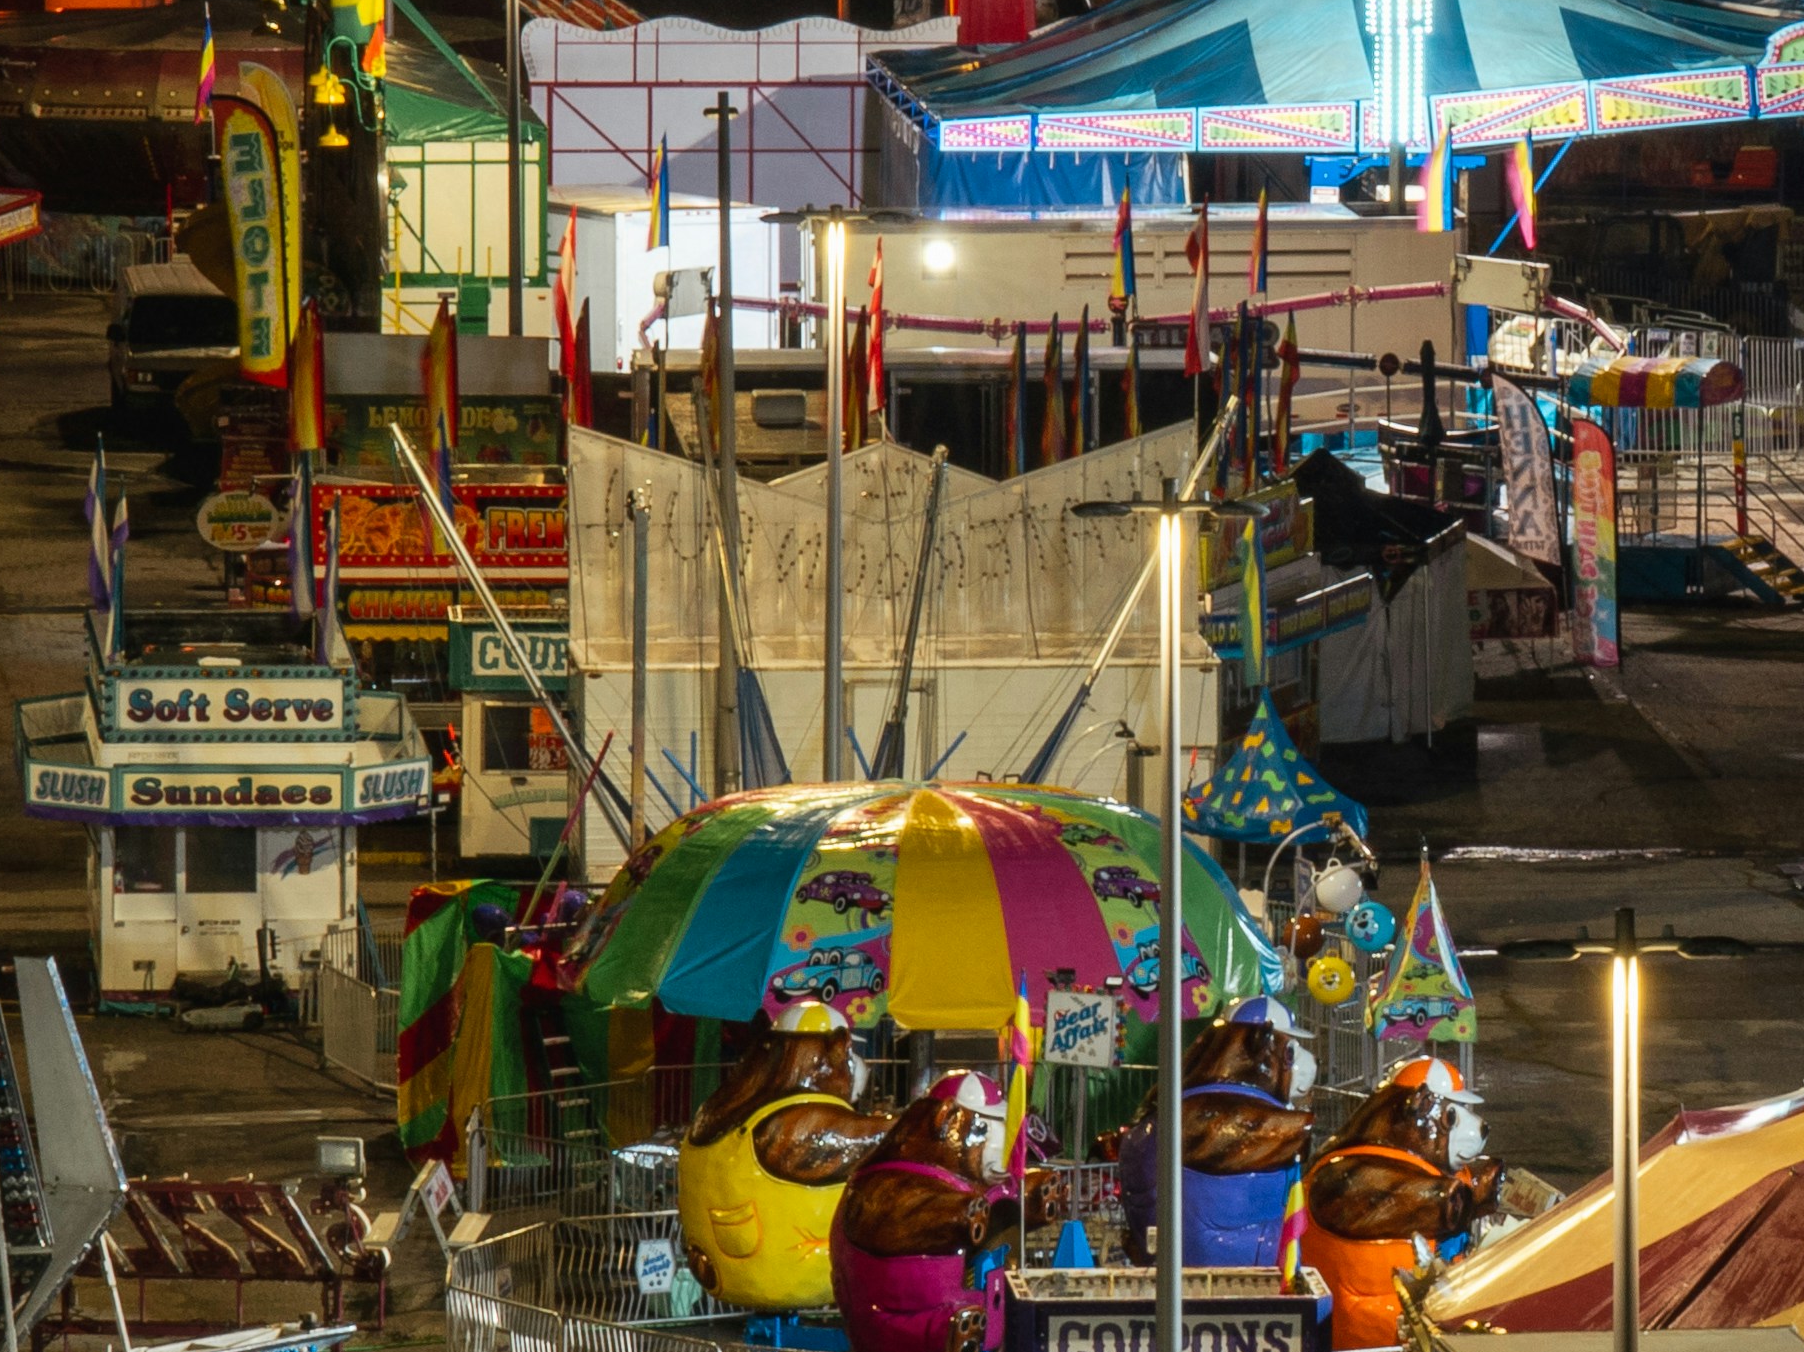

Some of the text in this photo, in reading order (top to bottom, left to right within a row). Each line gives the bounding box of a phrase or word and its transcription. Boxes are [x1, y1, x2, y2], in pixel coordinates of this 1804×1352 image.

[369, 405, 496, 430] LEMODE
[488, 508, 568, 548] FREN
[348, 591, 448, 619] CHICKEN
[127, 688, 334, 723] Soft Serve
[35, 770, 106, 805] SLUSH
[130, 776, 334, 807] Sundaes
[359, 766, 426, 803] SLUSH
[1050, 1014, 1109, 1053] Affair
[1053, 1001, 1103, 1033] Bear
